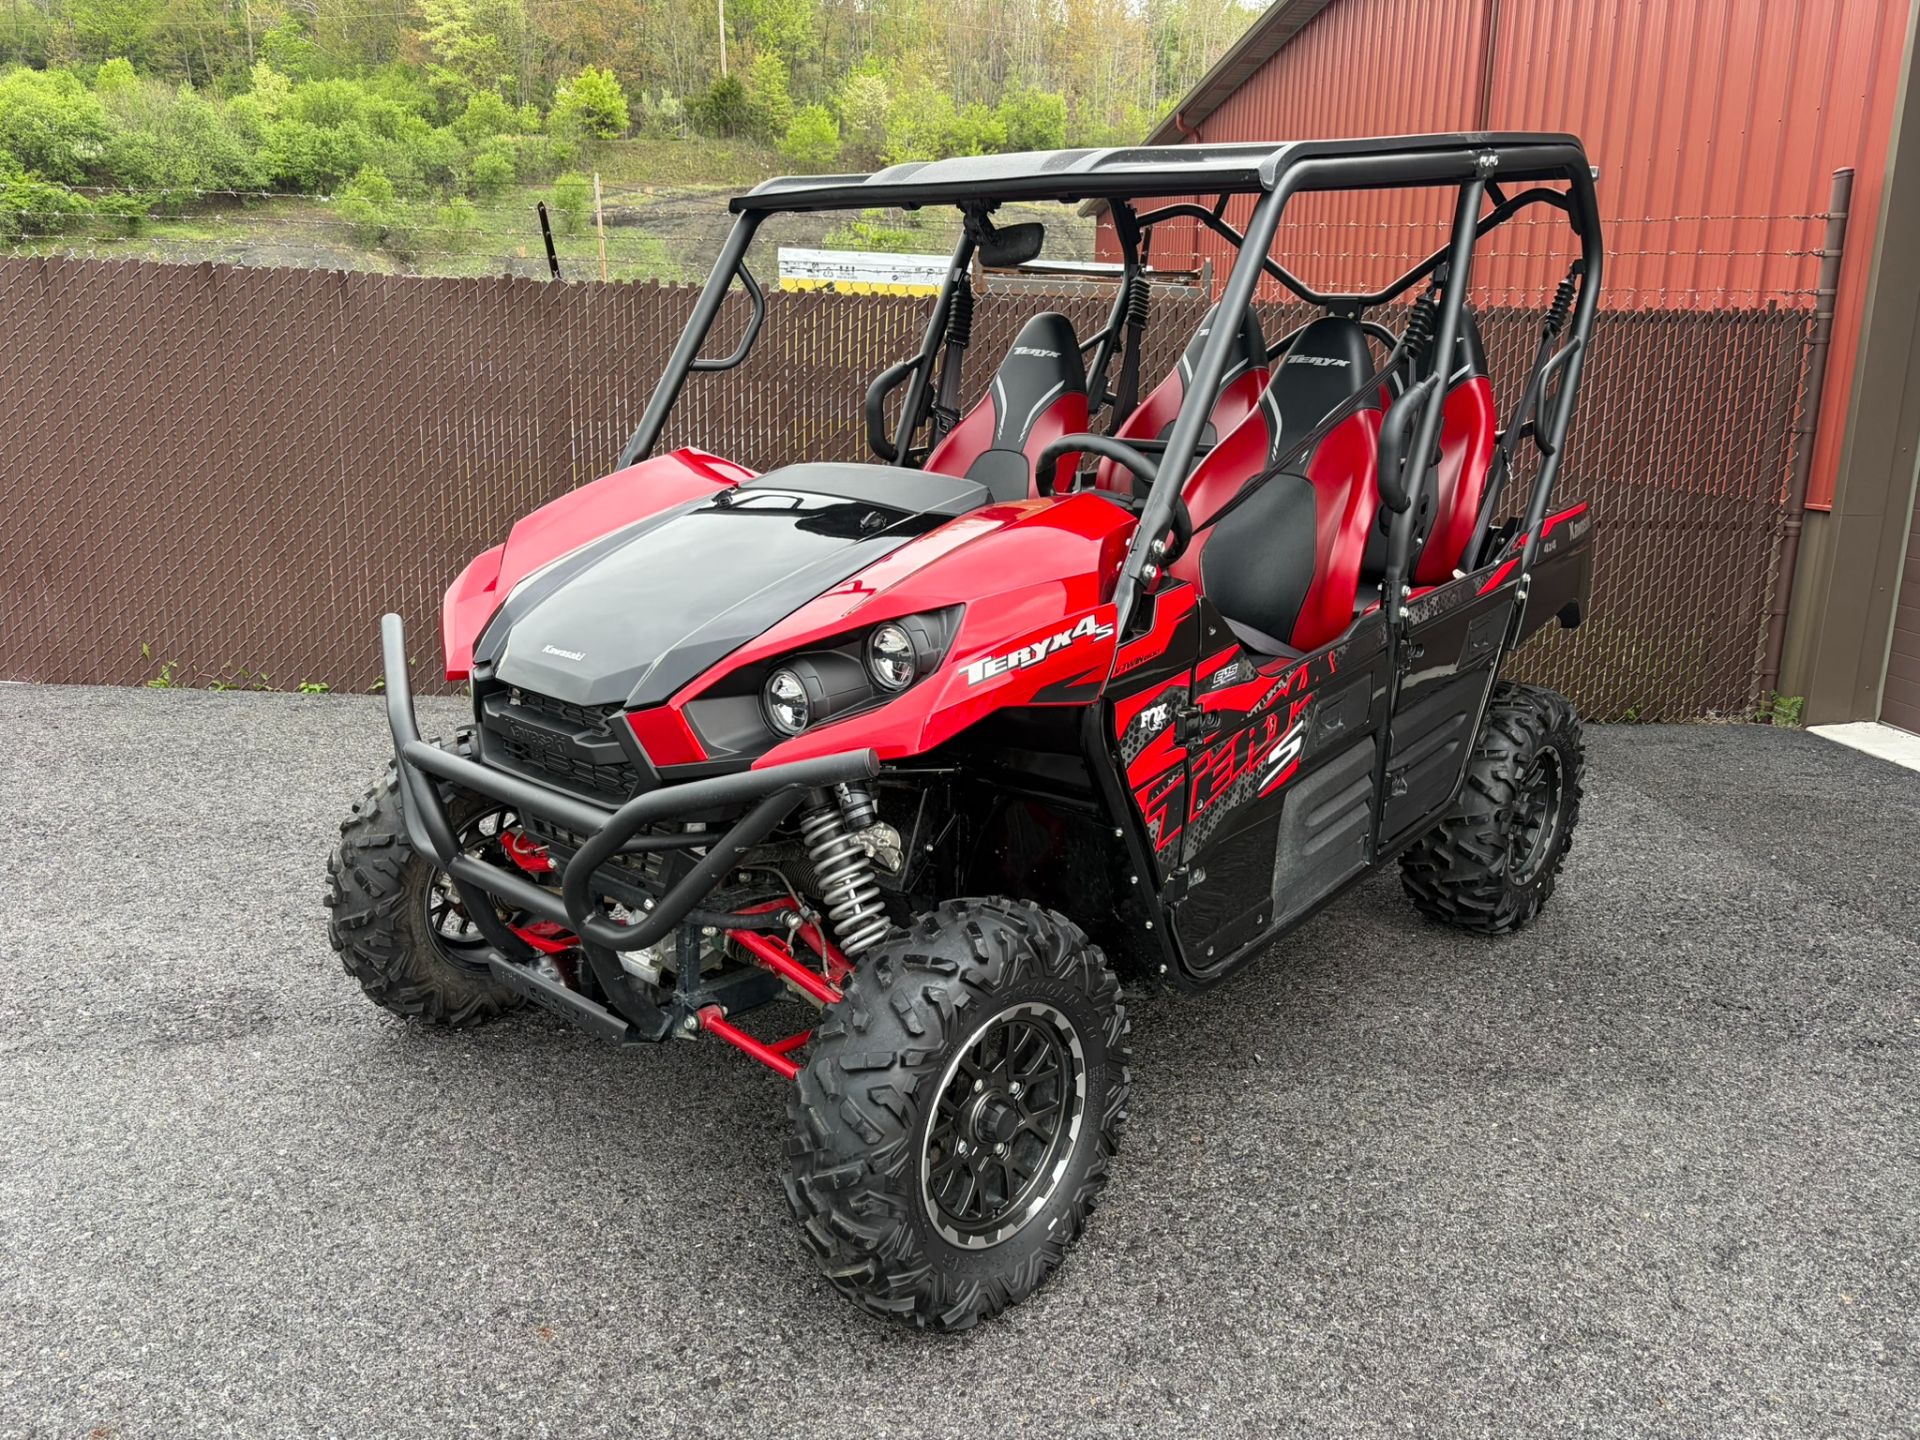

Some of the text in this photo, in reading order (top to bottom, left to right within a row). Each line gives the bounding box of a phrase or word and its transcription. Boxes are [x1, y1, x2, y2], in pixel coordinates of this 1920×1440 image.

[1287, 354, 1351, 367] TERYX
[542, 644, 586, 661] Kawasaki
[1140, 703, 1168, 731] FOX
